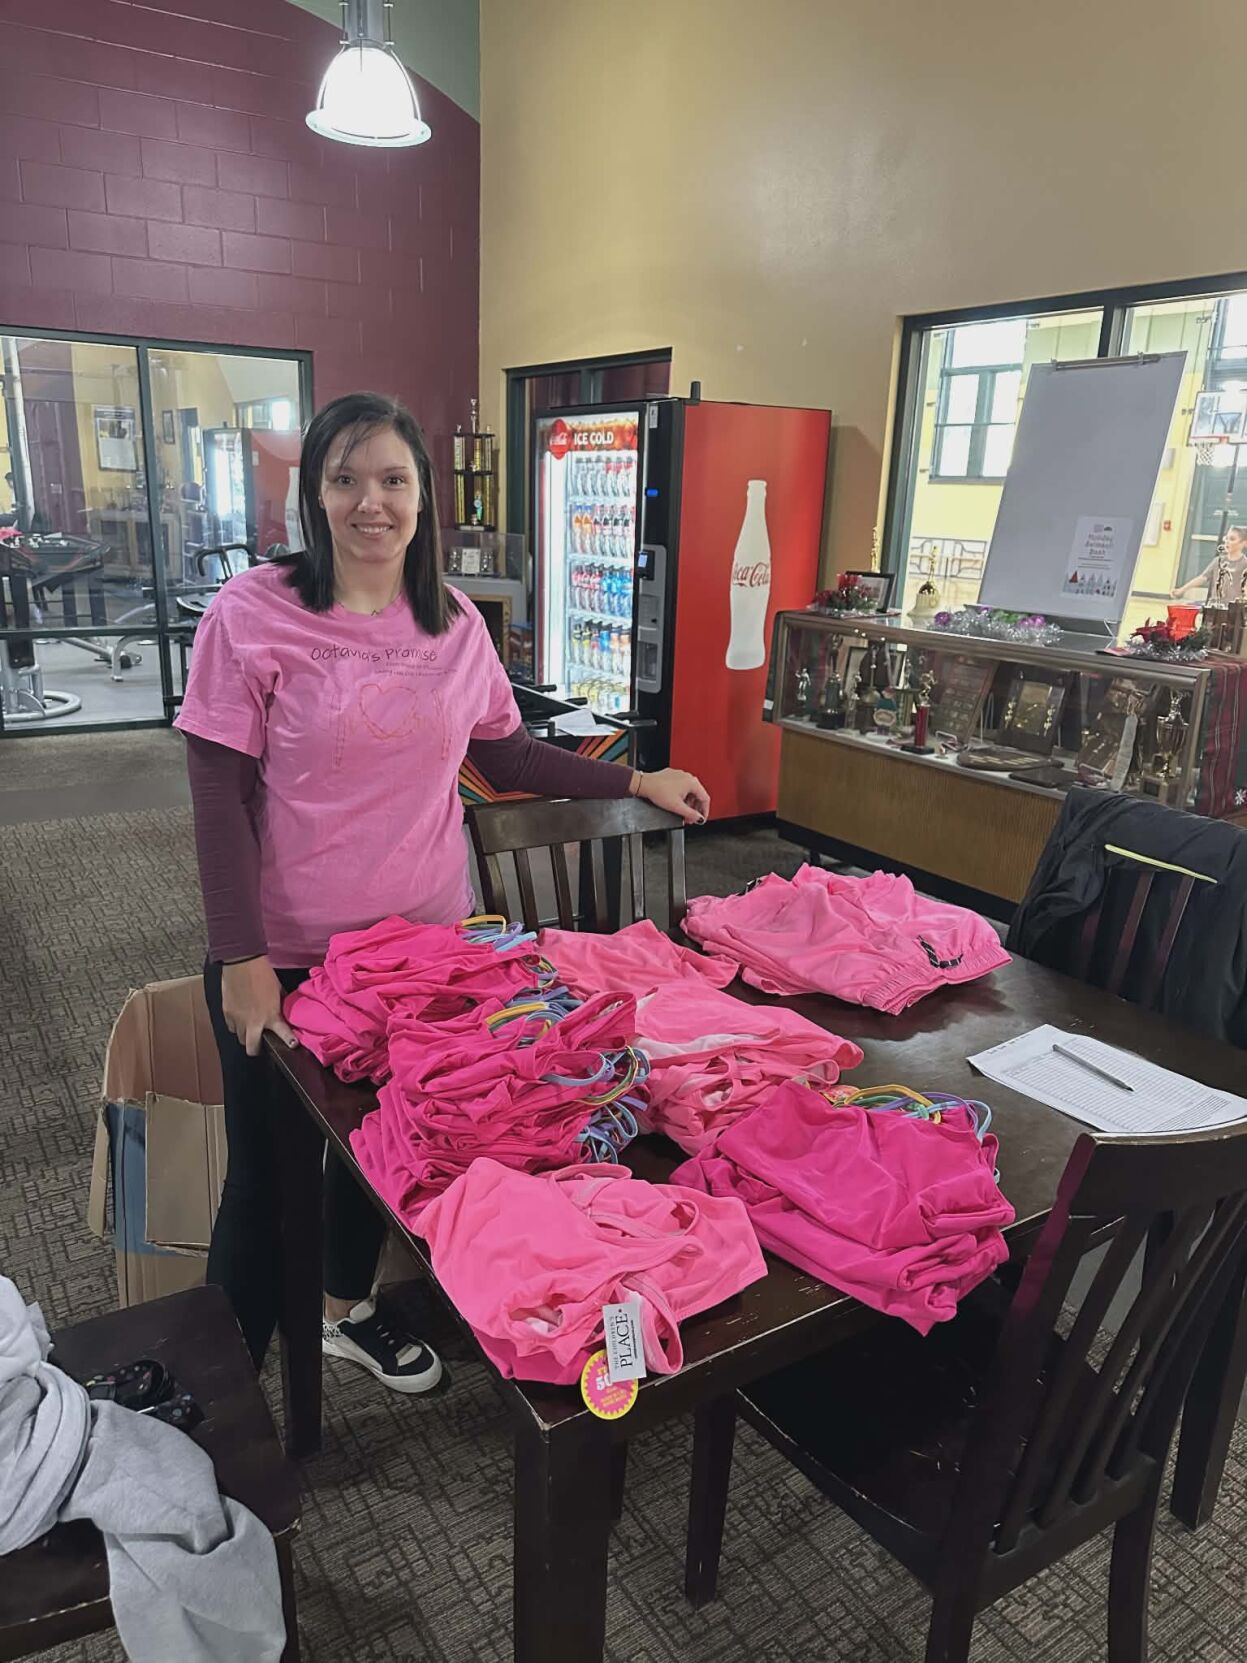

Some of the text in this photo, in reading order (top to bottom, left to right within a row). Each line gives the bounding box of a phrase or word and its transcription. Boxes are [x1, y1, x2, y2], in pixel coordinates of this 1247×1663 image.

[574, 432, 589, 446] ICE
[590, 431, 614, 446] COLD
[733, 562, 769, 587] ca-Cola
[615, 1313, 632, 1367] PLACE
